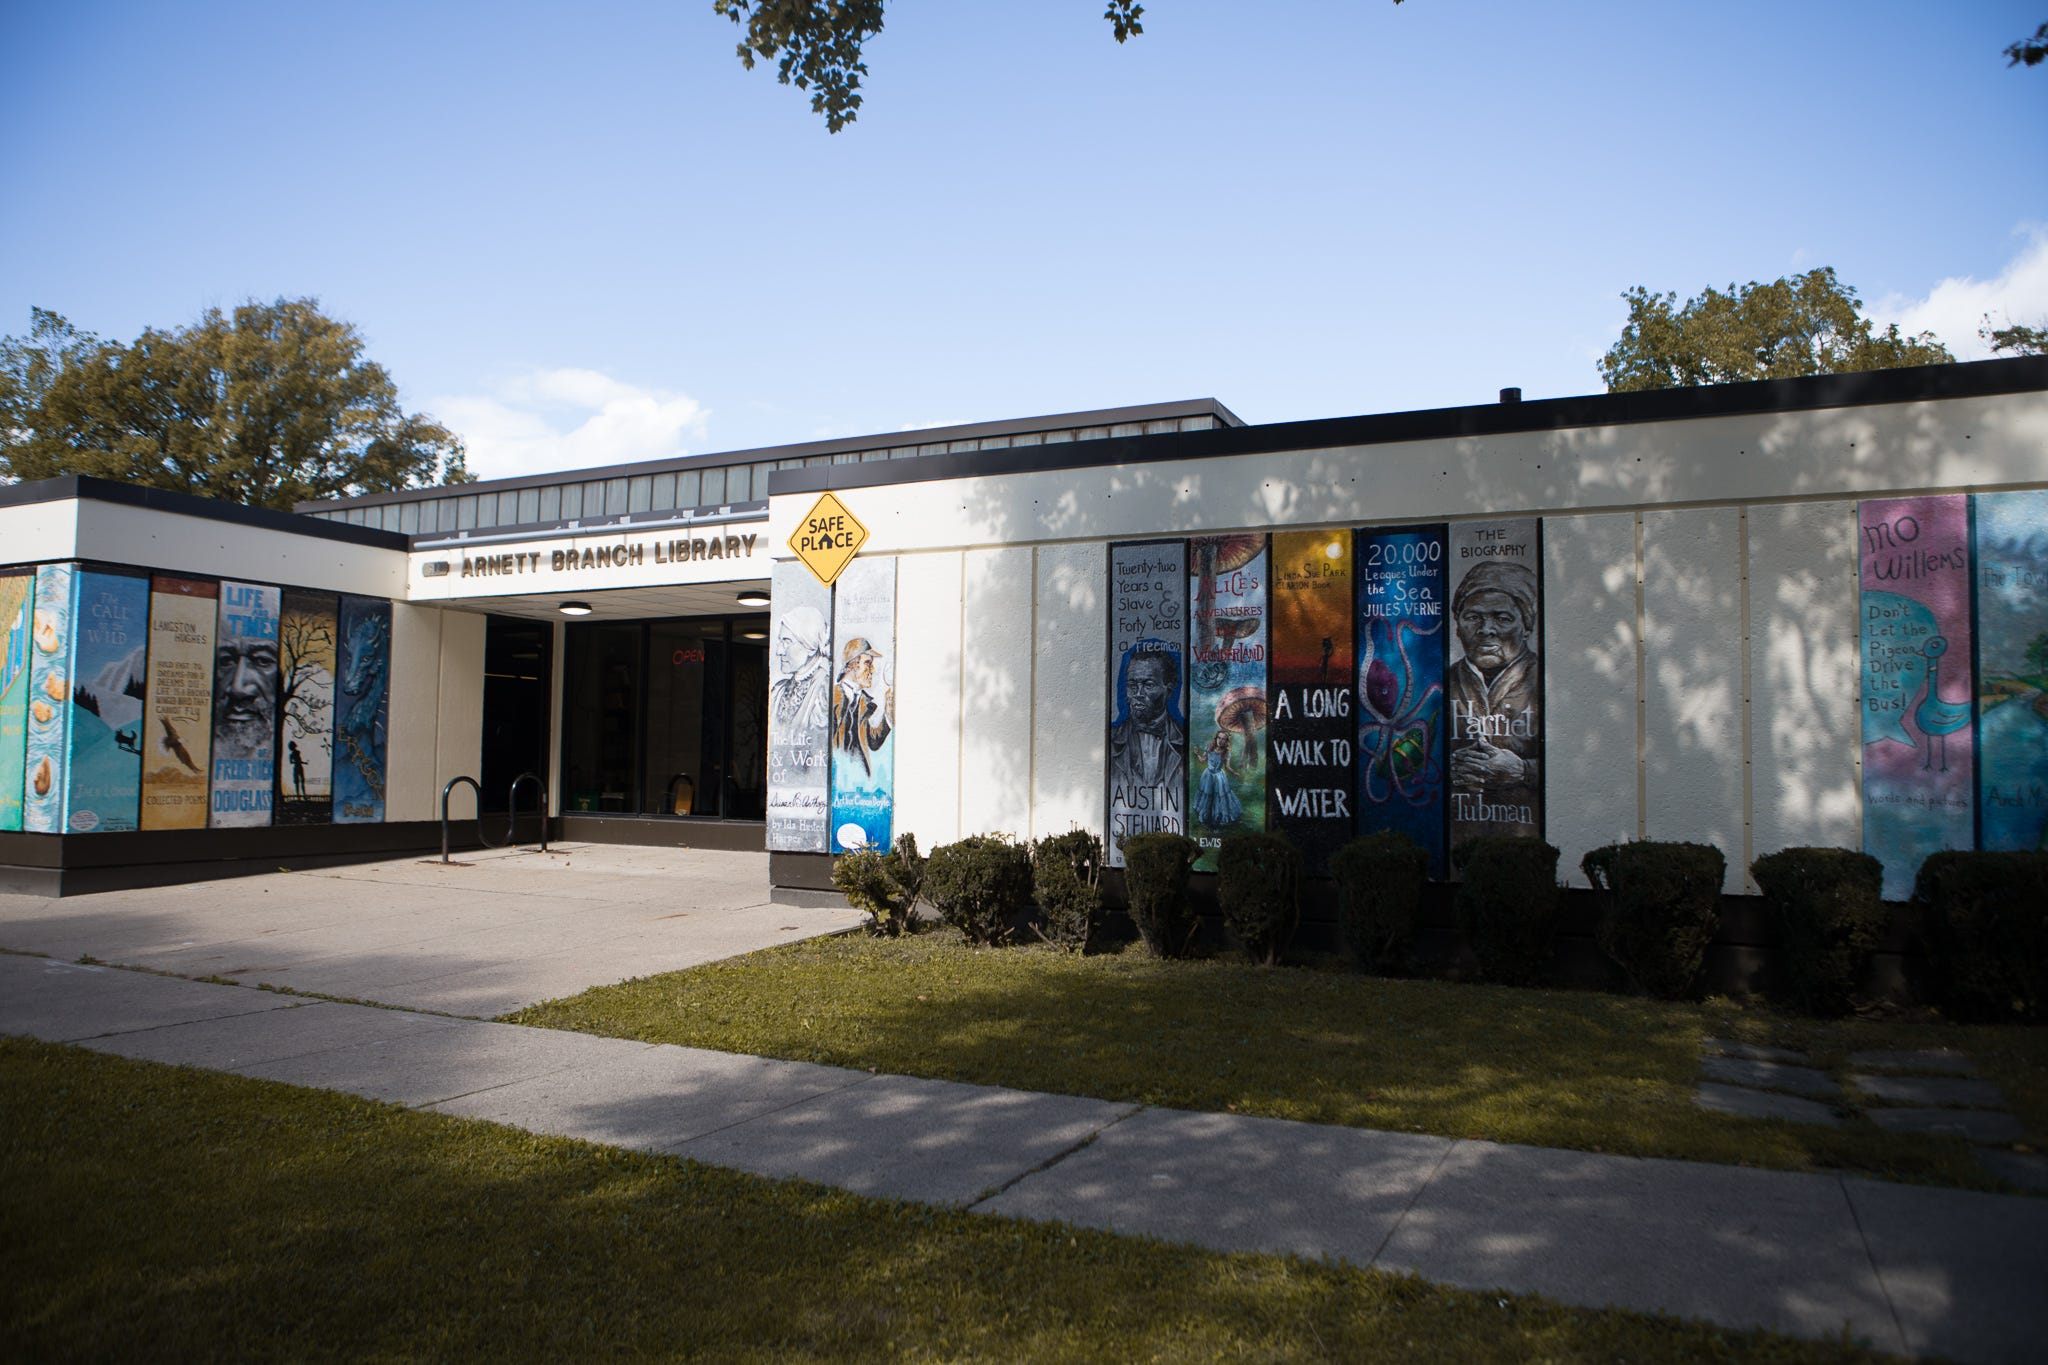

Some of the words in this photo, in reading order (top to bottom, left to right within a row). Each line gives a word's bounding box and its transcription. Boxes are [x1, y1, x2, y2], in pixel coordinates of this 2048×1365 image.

[808, 515, 844, 533] SAFE
[1475, 529, 1507, 541] THE
[461, 551, 541, 578] ARNETT
[551, 543, 643, 572] BRANCH
[655, 533, 757, 564] LIBRARY
[1460, 544, 1527, 558] BIOGRAPHY
[1116, 557, 1177, 578] Twenty-two
[1365, 568, 1407, 585] Leagues
[1408, 565, 1439, 578] Under
[1117, 580, 1149, 594] Years
[1154, 582, 1163, 591] a
[1367, 583, 1386, 596] the
[1393, 580, 1433, 601] Sea
[226, 586, 264, 608] LIFE
[1118, 600, 1154, 611] Slave
[92, 604, 128, 619] CALL
[1363, 602, 1401, 617] JULES
[1403, 601, 1442, 616] VERNE
[1869, 602, 1911, 619] Don't
[153, 620, 196, 633] LANGSTON
[1119, 618, 1147, 635] Forty
[1150, 615, 1181, 631] Years
[1870, 624, 1895, 637] Let
[1902, 623, 1928, 635] the
[175, 633, 207, 644] HUGHES
[1119, 640, 1128, 651] a
[672, 649, 705, 665] OPEN
[1192, 642, 1265, 664] WONDERLAND
[1870, 641, 1916, 658] Pigeon
[1870, 660, 1914, 674] Drive
[1870, 678, 1900, 691] the
[1274, 688, 1293, 720] A
[1302, 688, 1351, 718] LONG
[1869, 693, 1907, 712] Bus!
[1450, 699, 1538, 740] Harriet
[772, 731, 789, 746] The
[790, 730, 813, 746] Life
[771, 751, 783, 767] &
[790, 750, 828, 767] Work
[1273, 740, 1328, 767] WALK
[1331, 738, 1351, 768] TO
[772, 769, 787, 783] of
[1112, 785, 1179, 812] AUSTIN
[1275, 787, 1351, 819] WATER
[1451, 790, 1535, 825] Tubman
[772, 820, 781, 832] by
[783, 819, 796, 830] Ida
[1112, 813, 1181, 838] STEWARD
[1193, 837, 1222, 848] EWIS
